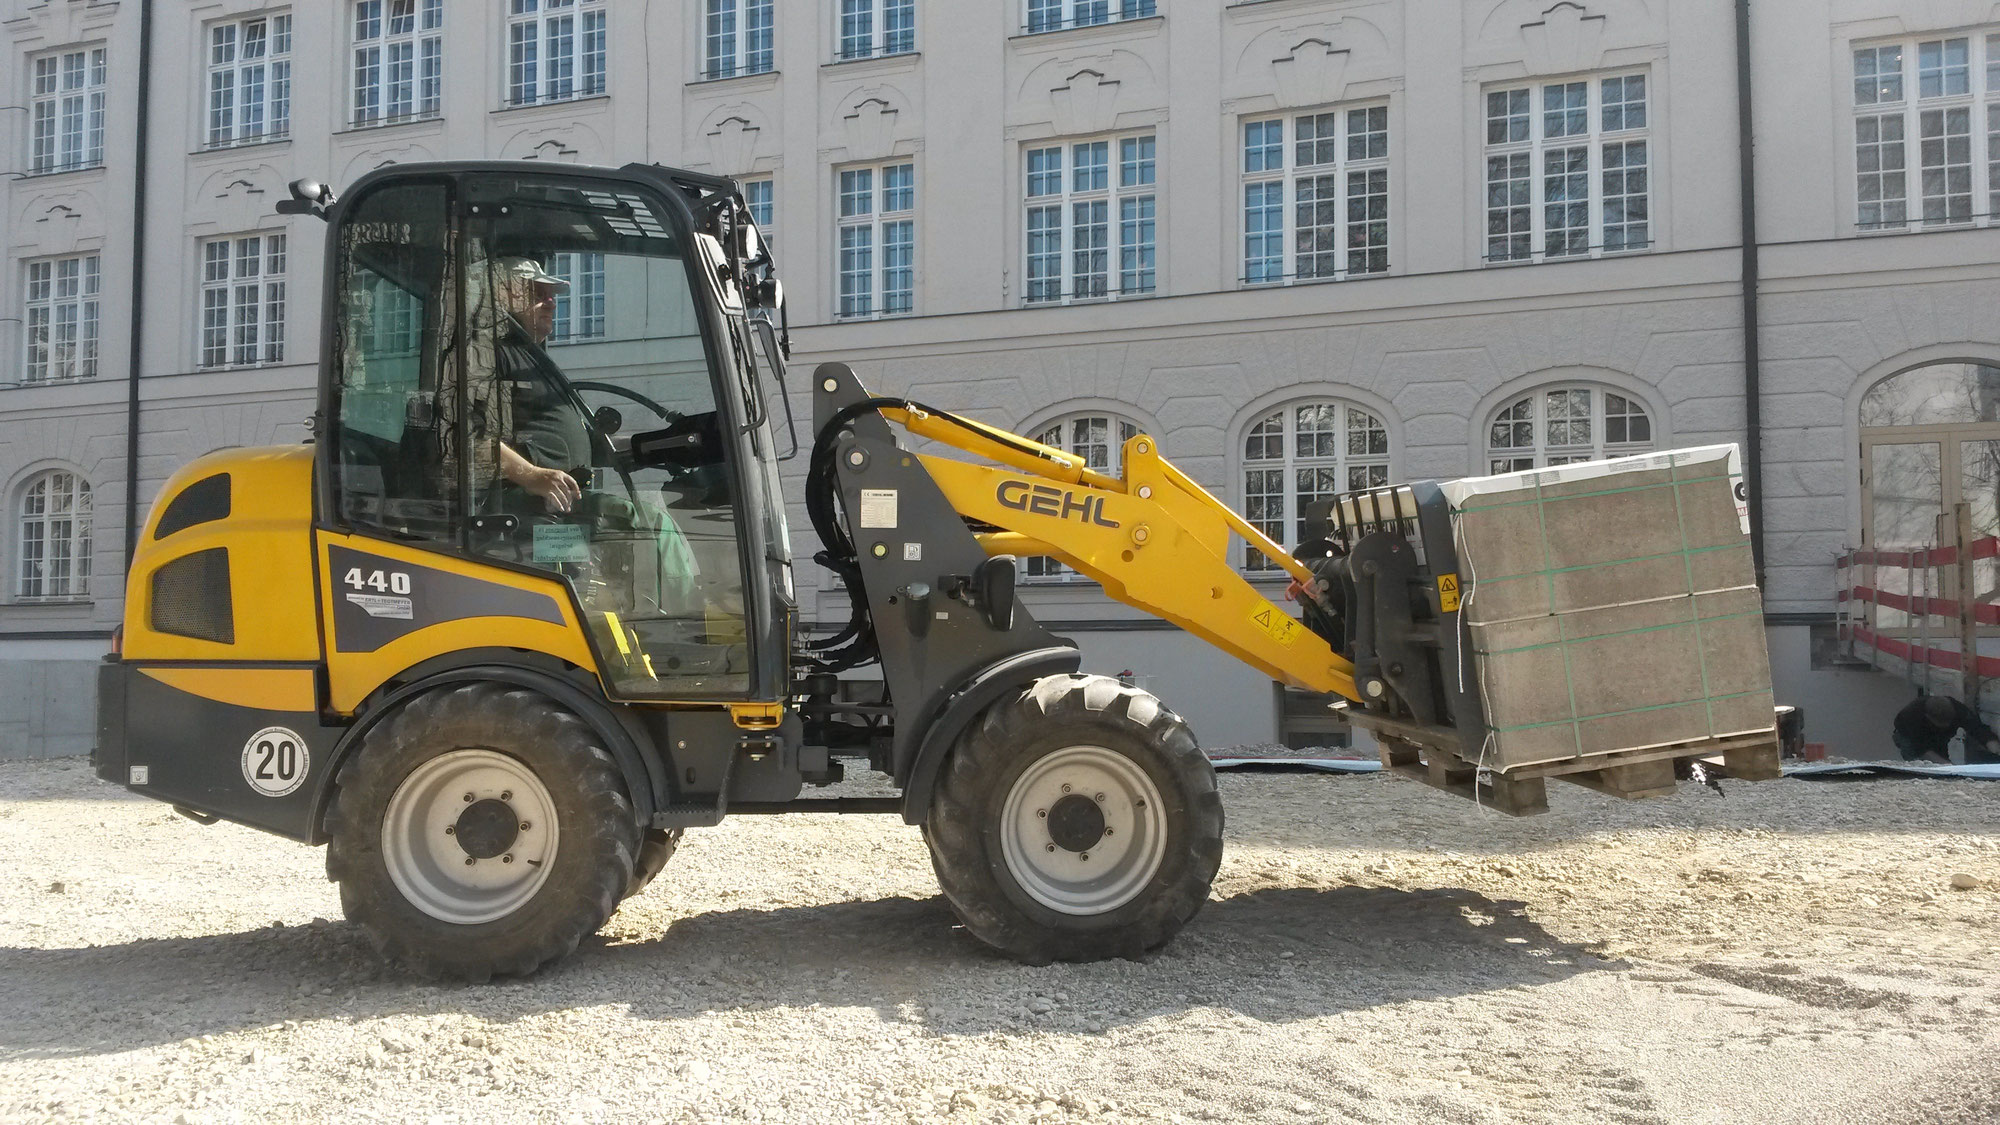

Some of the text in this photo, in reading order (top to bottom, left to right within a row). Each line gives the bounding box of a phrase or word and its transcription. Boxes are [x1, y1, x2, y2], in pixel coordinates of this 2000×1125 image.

[997, 480, 1120, 529] GEHL
[344, 567, 411, 595] 440
[255, 740, 296, 780] 20
